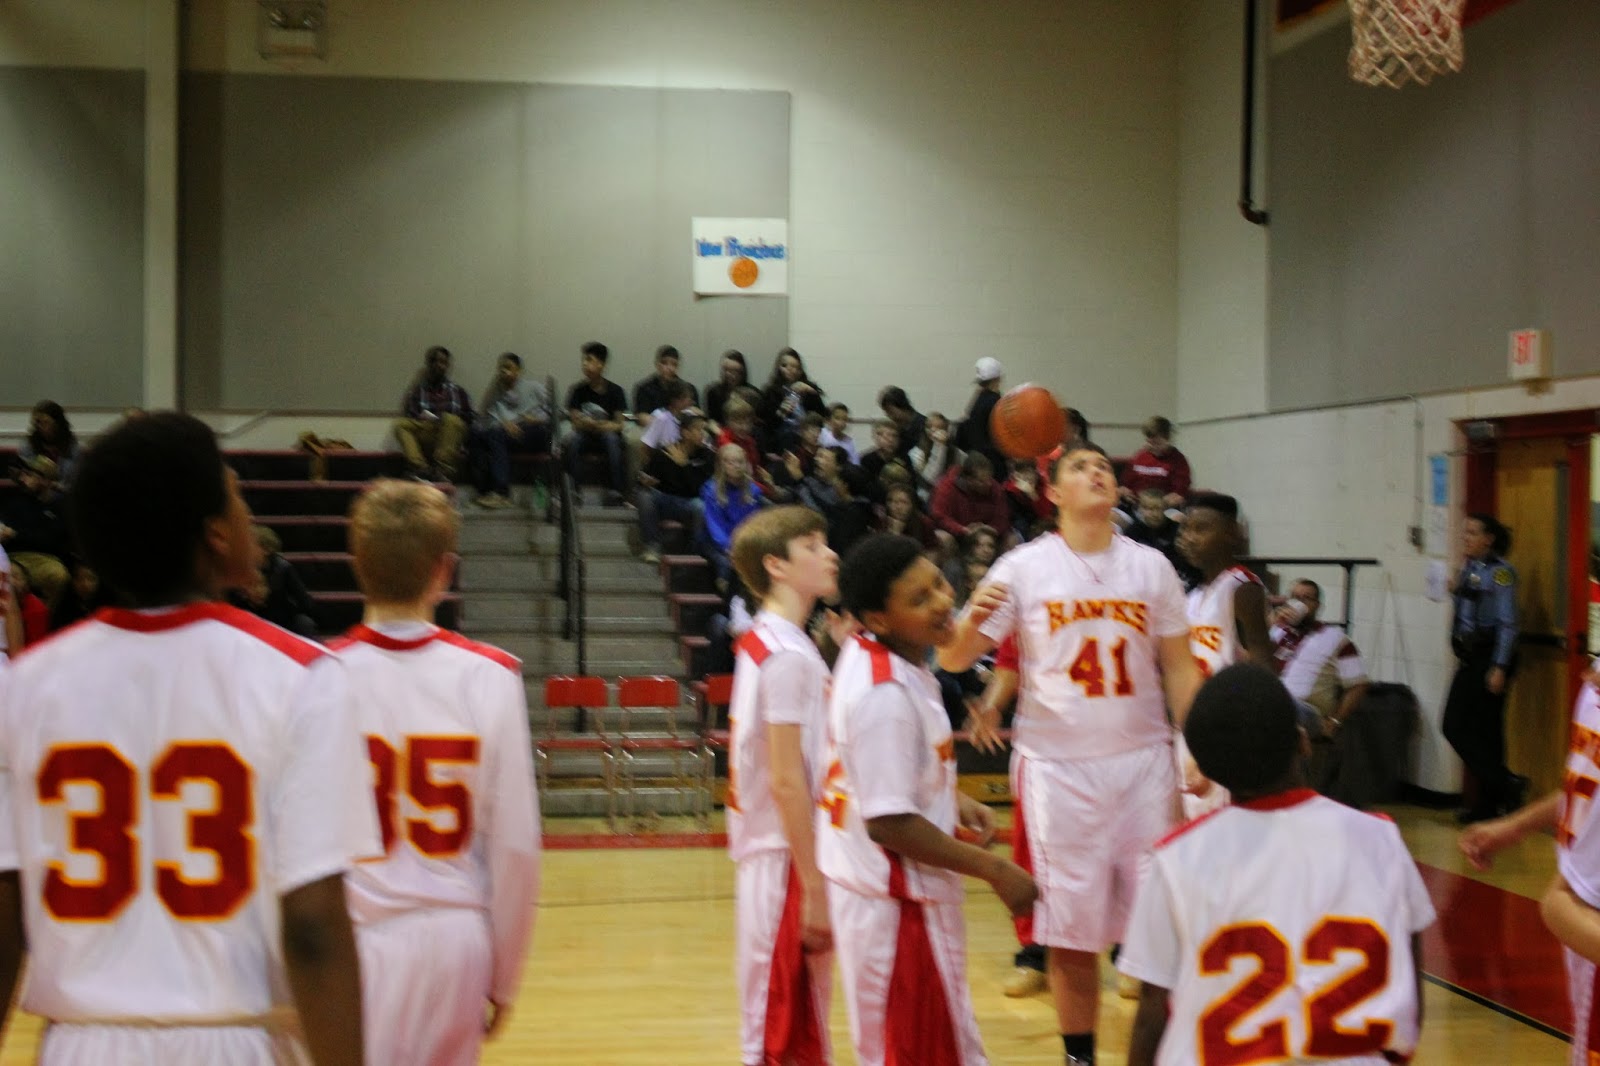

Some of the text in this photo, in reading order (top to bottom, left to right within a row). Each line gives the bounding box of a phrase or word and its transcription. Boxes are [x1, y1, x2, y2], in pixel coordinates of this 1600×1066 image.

[1046, 598, 1149, 636] HAWKS
[1067, 636, 1136, 698] 41
[36, 740, 257, 923] 33
[1197, 914, 1395, 1066] 22
